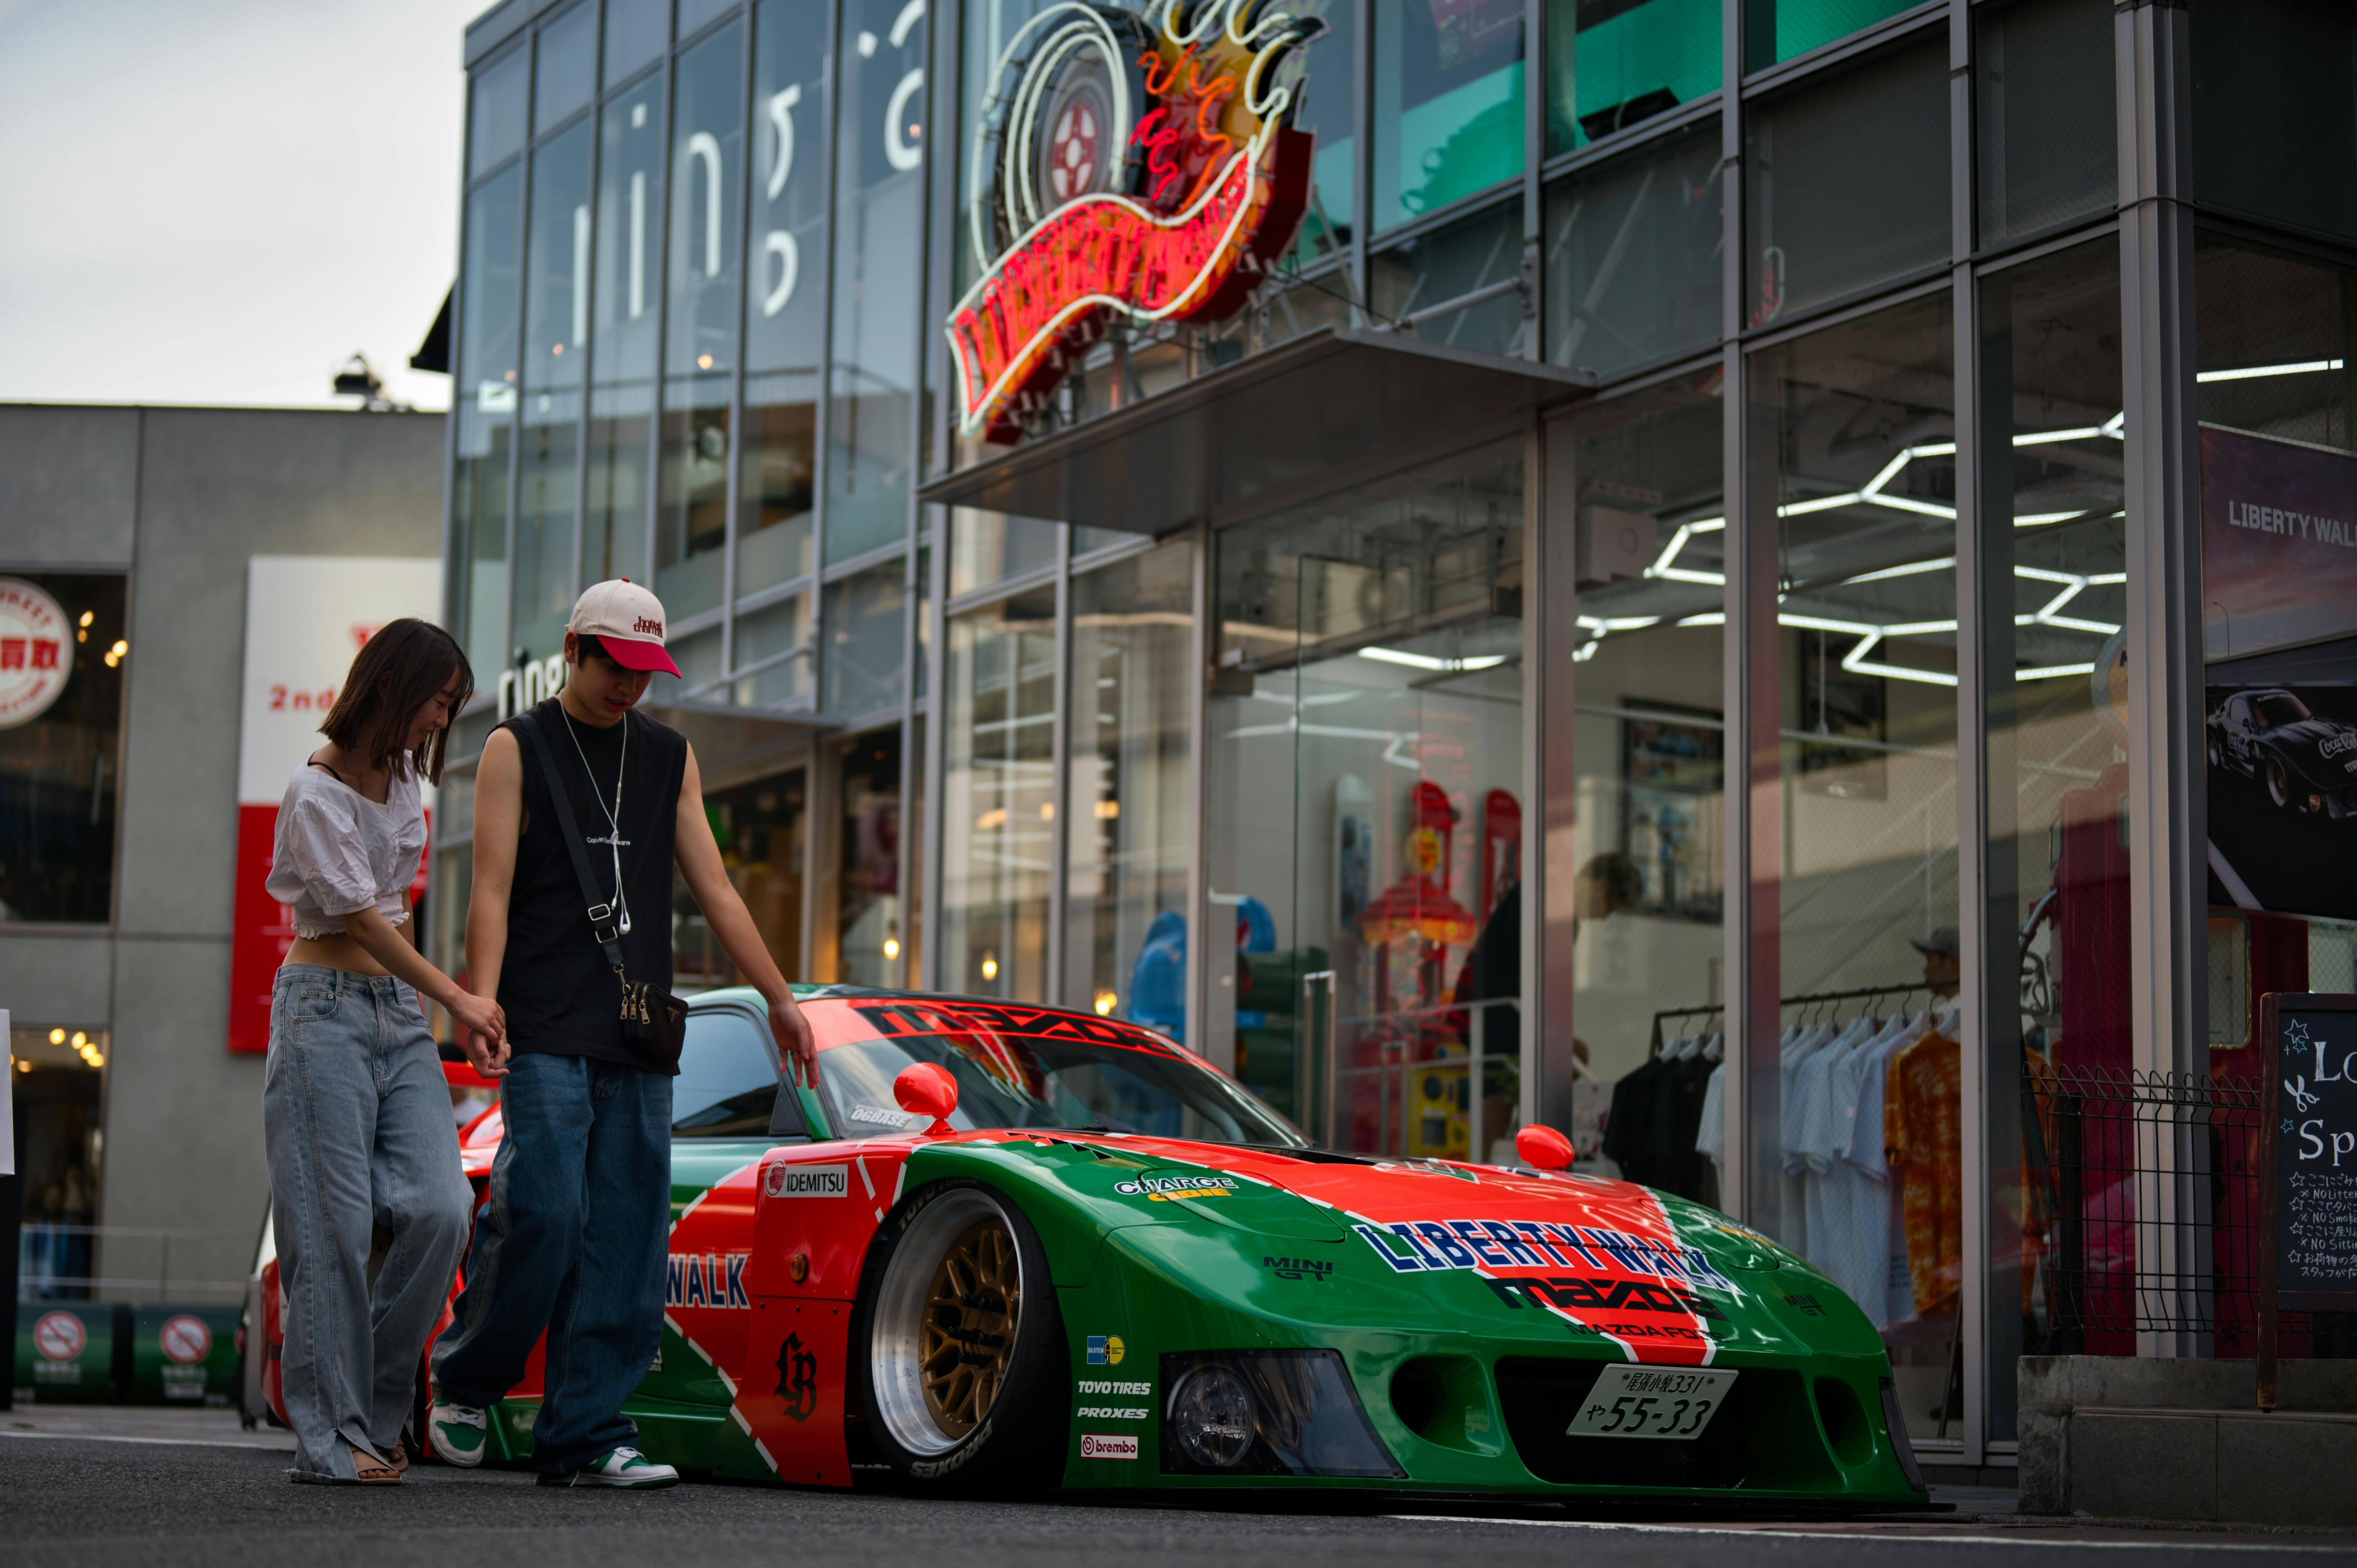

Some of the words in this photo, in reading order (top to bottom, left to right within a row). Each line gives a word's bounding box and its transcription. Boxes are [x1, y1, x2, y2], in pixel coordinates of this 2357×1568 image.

[2229, 500, 2311, 538] LIBERTY
[2314, 516, 2357, 548] WAL
[2299, 1119, 2355, 1166] Sp
[787, 1174, 844, 1193] IDEMITSU
[1114, 1177, 1239, 1194] CHARGE
[2308, 1173, 2357, 1187] ここにごみ
[2313, 1212, 2326, 1223] NO
[2311, 1238, 2325, 1250] NO
[1264, 1257, 1332, 1271] MINI
[1351, 1219, 1608, 1273] LIBERTY
[1583, 1228, 1747, 1296] WALK
[1274, 1268, 1332, 1281] GT
[1783, 1294, 1818, 1306] MINI
[1563, 1323, 1666, 1337] MAZDA
[1078, 1381, 1111, 1394] TOYO
[1112, 1382, 1151, 1395] TIRES
[1077, 1407, 1149, 1419] PROXES
[909, 1418, 993, 1479] PROXES
[1096, 1440, 1136, 1453] brembo
